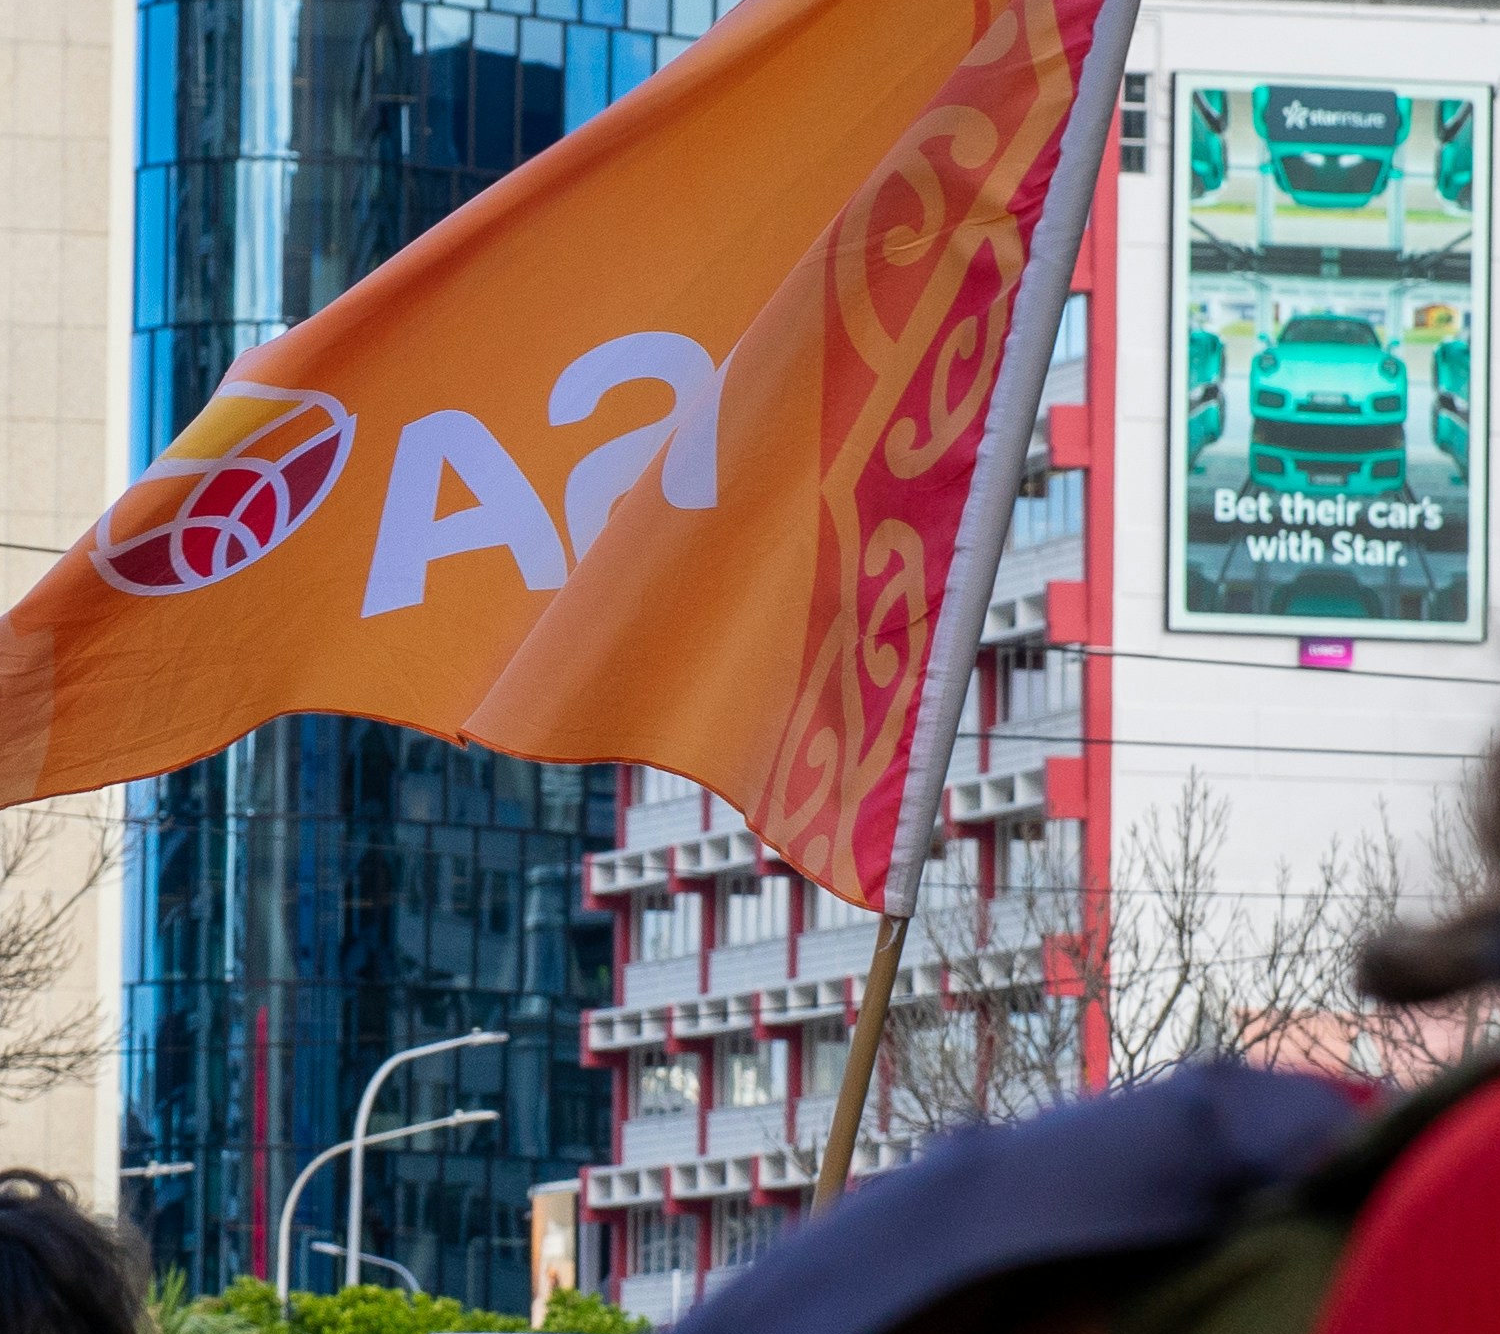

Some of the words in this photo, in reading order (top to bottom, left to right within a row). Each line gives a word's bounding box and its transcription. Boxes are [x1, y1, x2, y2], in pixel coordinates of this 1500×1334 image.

[1213, 488, 1273, 524] Bet
[1280, 491, 1363, 527] their
[1368, 495, 1444, 531] car's
[1246, 528, 1324, 564] with
[1331, 530, 1409, 567] Star.
